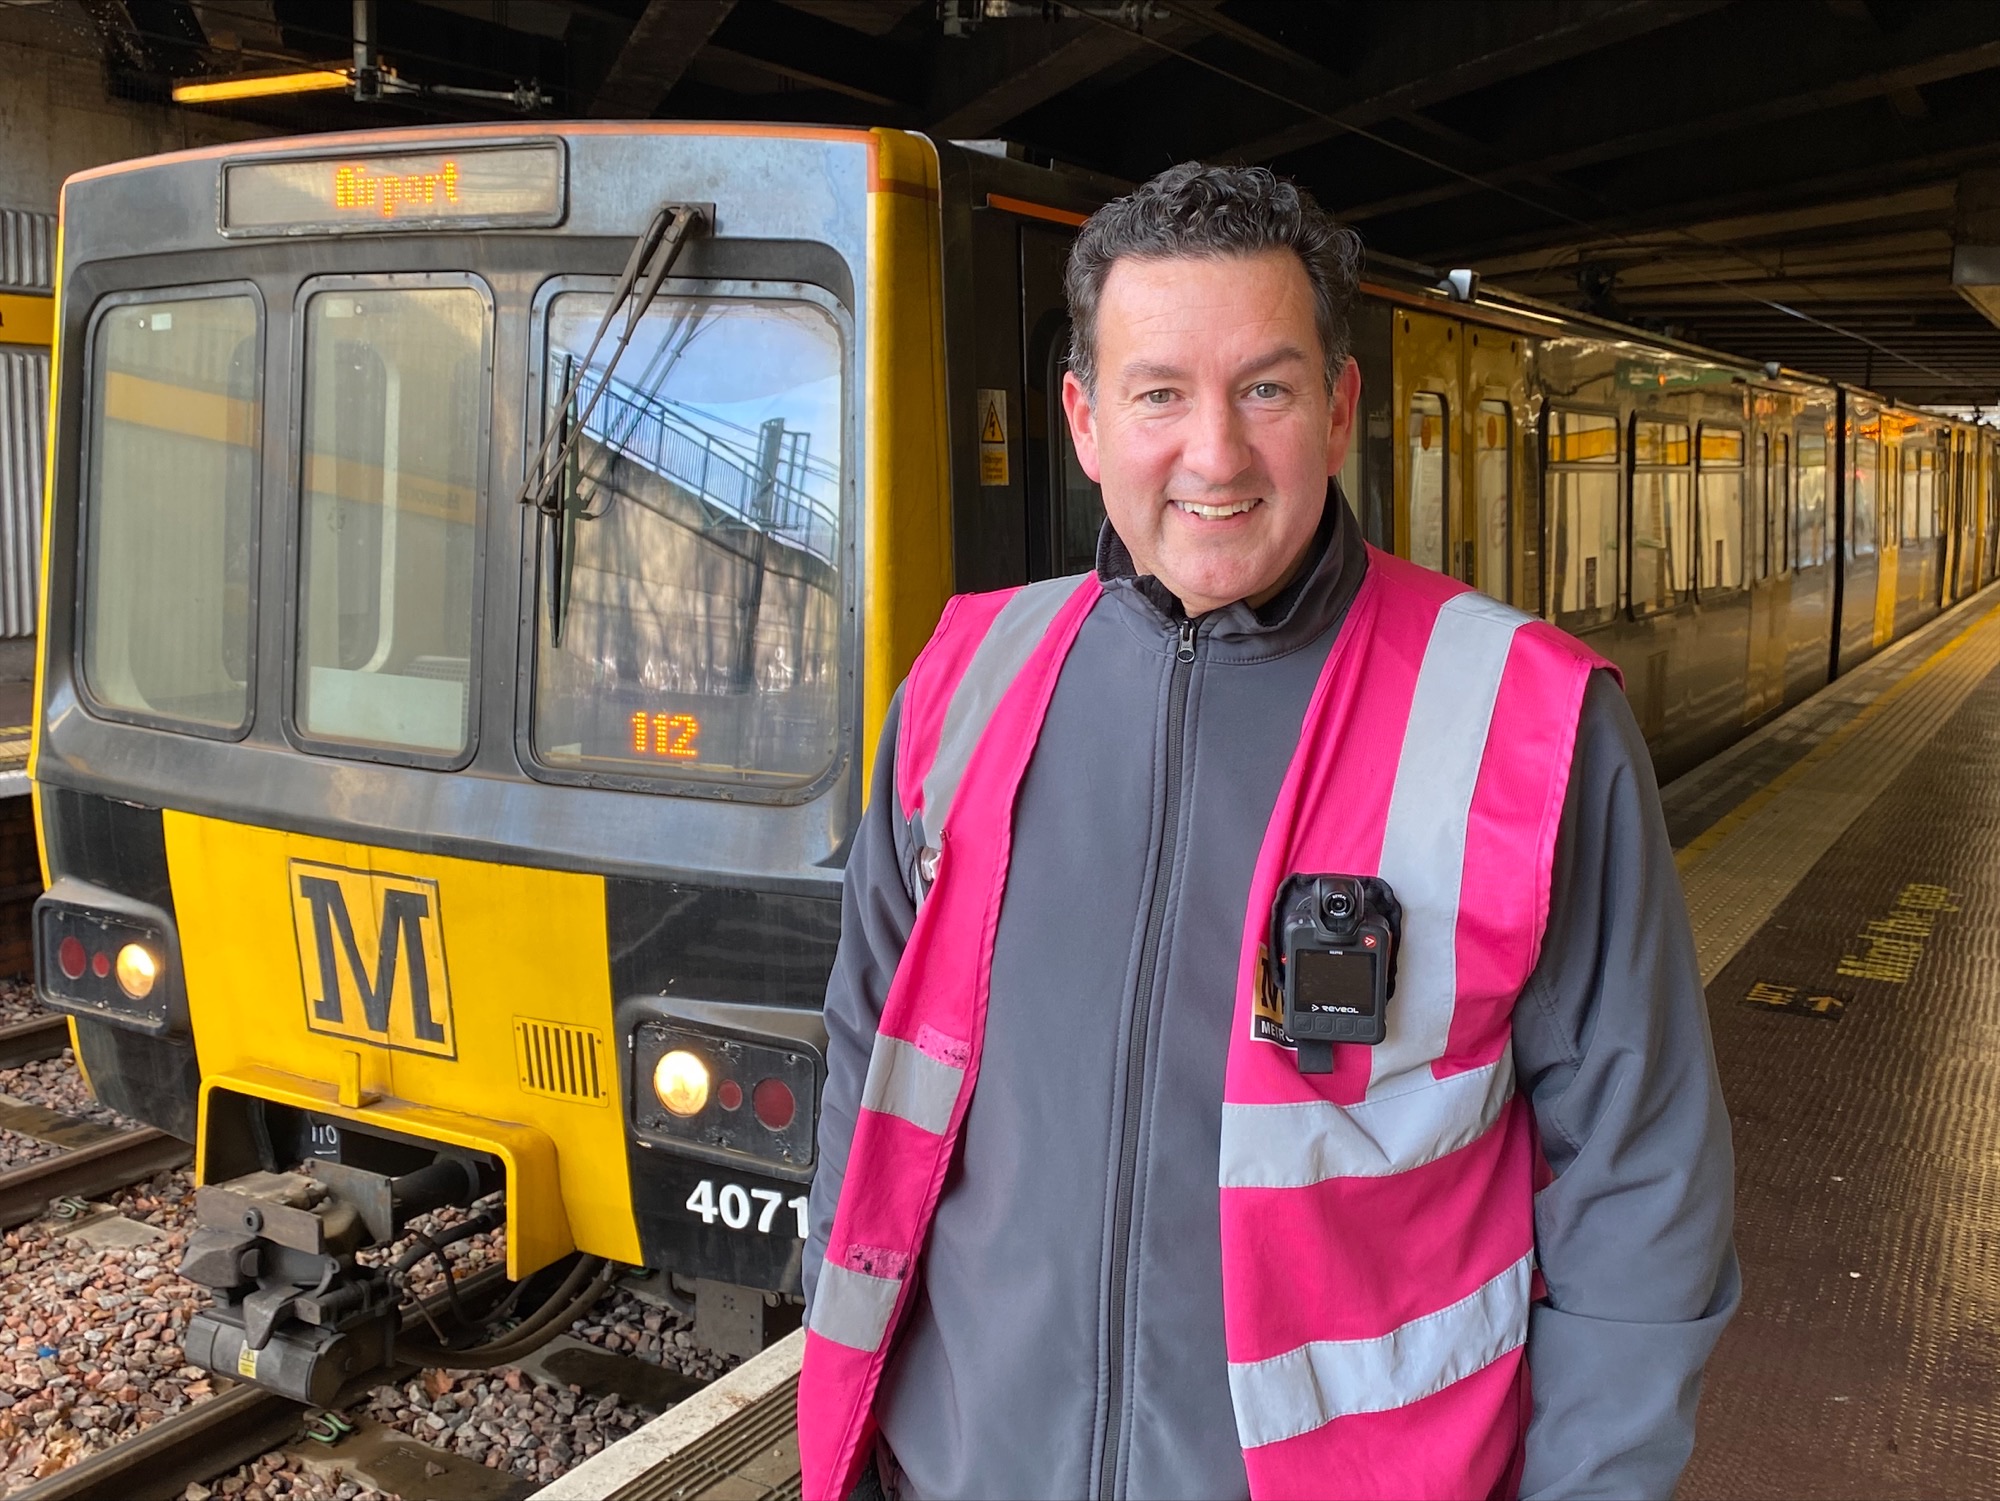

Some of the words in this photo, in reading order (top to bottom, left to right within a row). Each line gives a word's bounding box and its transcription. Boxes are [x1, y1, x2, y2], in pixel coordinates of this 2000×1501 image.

[336, 161, 459, 216] Airport
[631, 711, 697, 757] 112
[298, 874, 445, 1044] M
[685, 1179, 810, 1240] 4071
